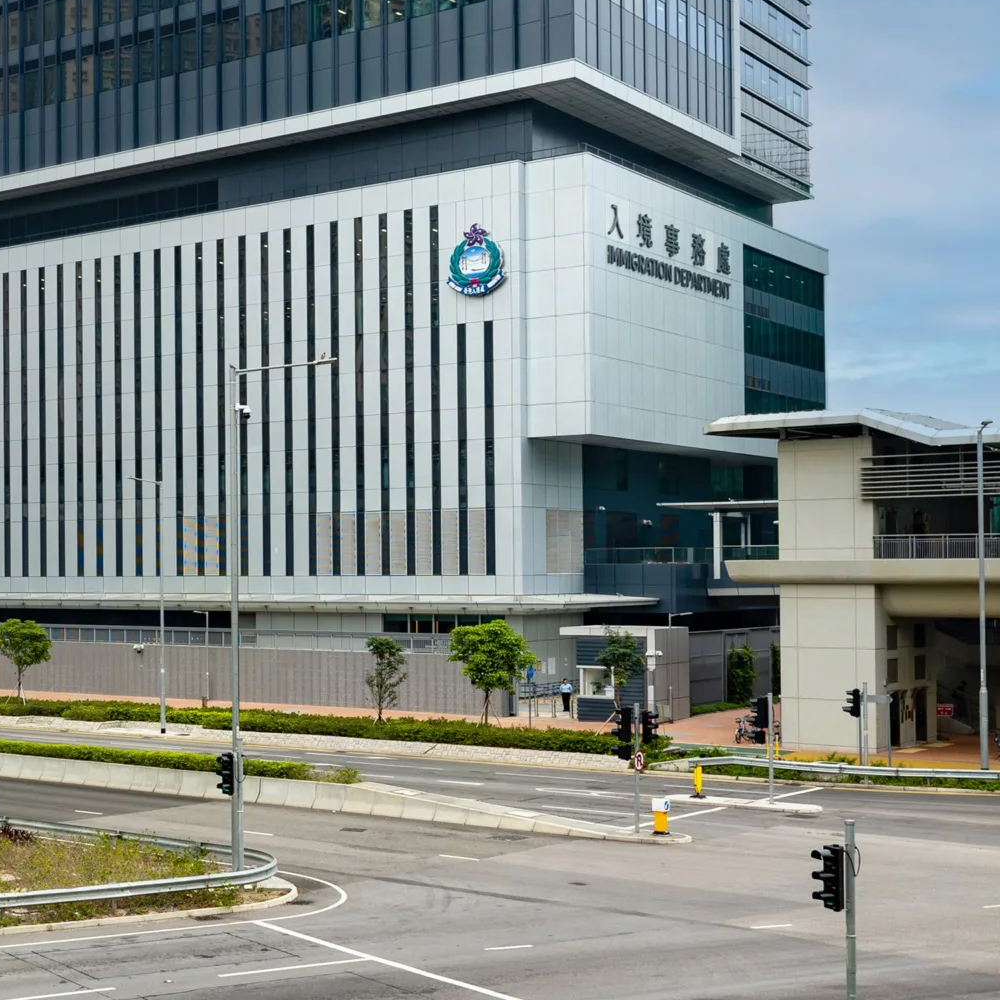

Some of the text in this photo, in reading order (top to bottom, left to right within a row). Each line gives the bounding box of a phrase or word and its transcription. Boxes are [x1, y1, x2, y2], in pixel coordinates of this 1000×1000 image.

[607, 204, 731, 275] 入境事務處
[607, 244, 731, 300] IMMIGRATION DEPARTMENT
